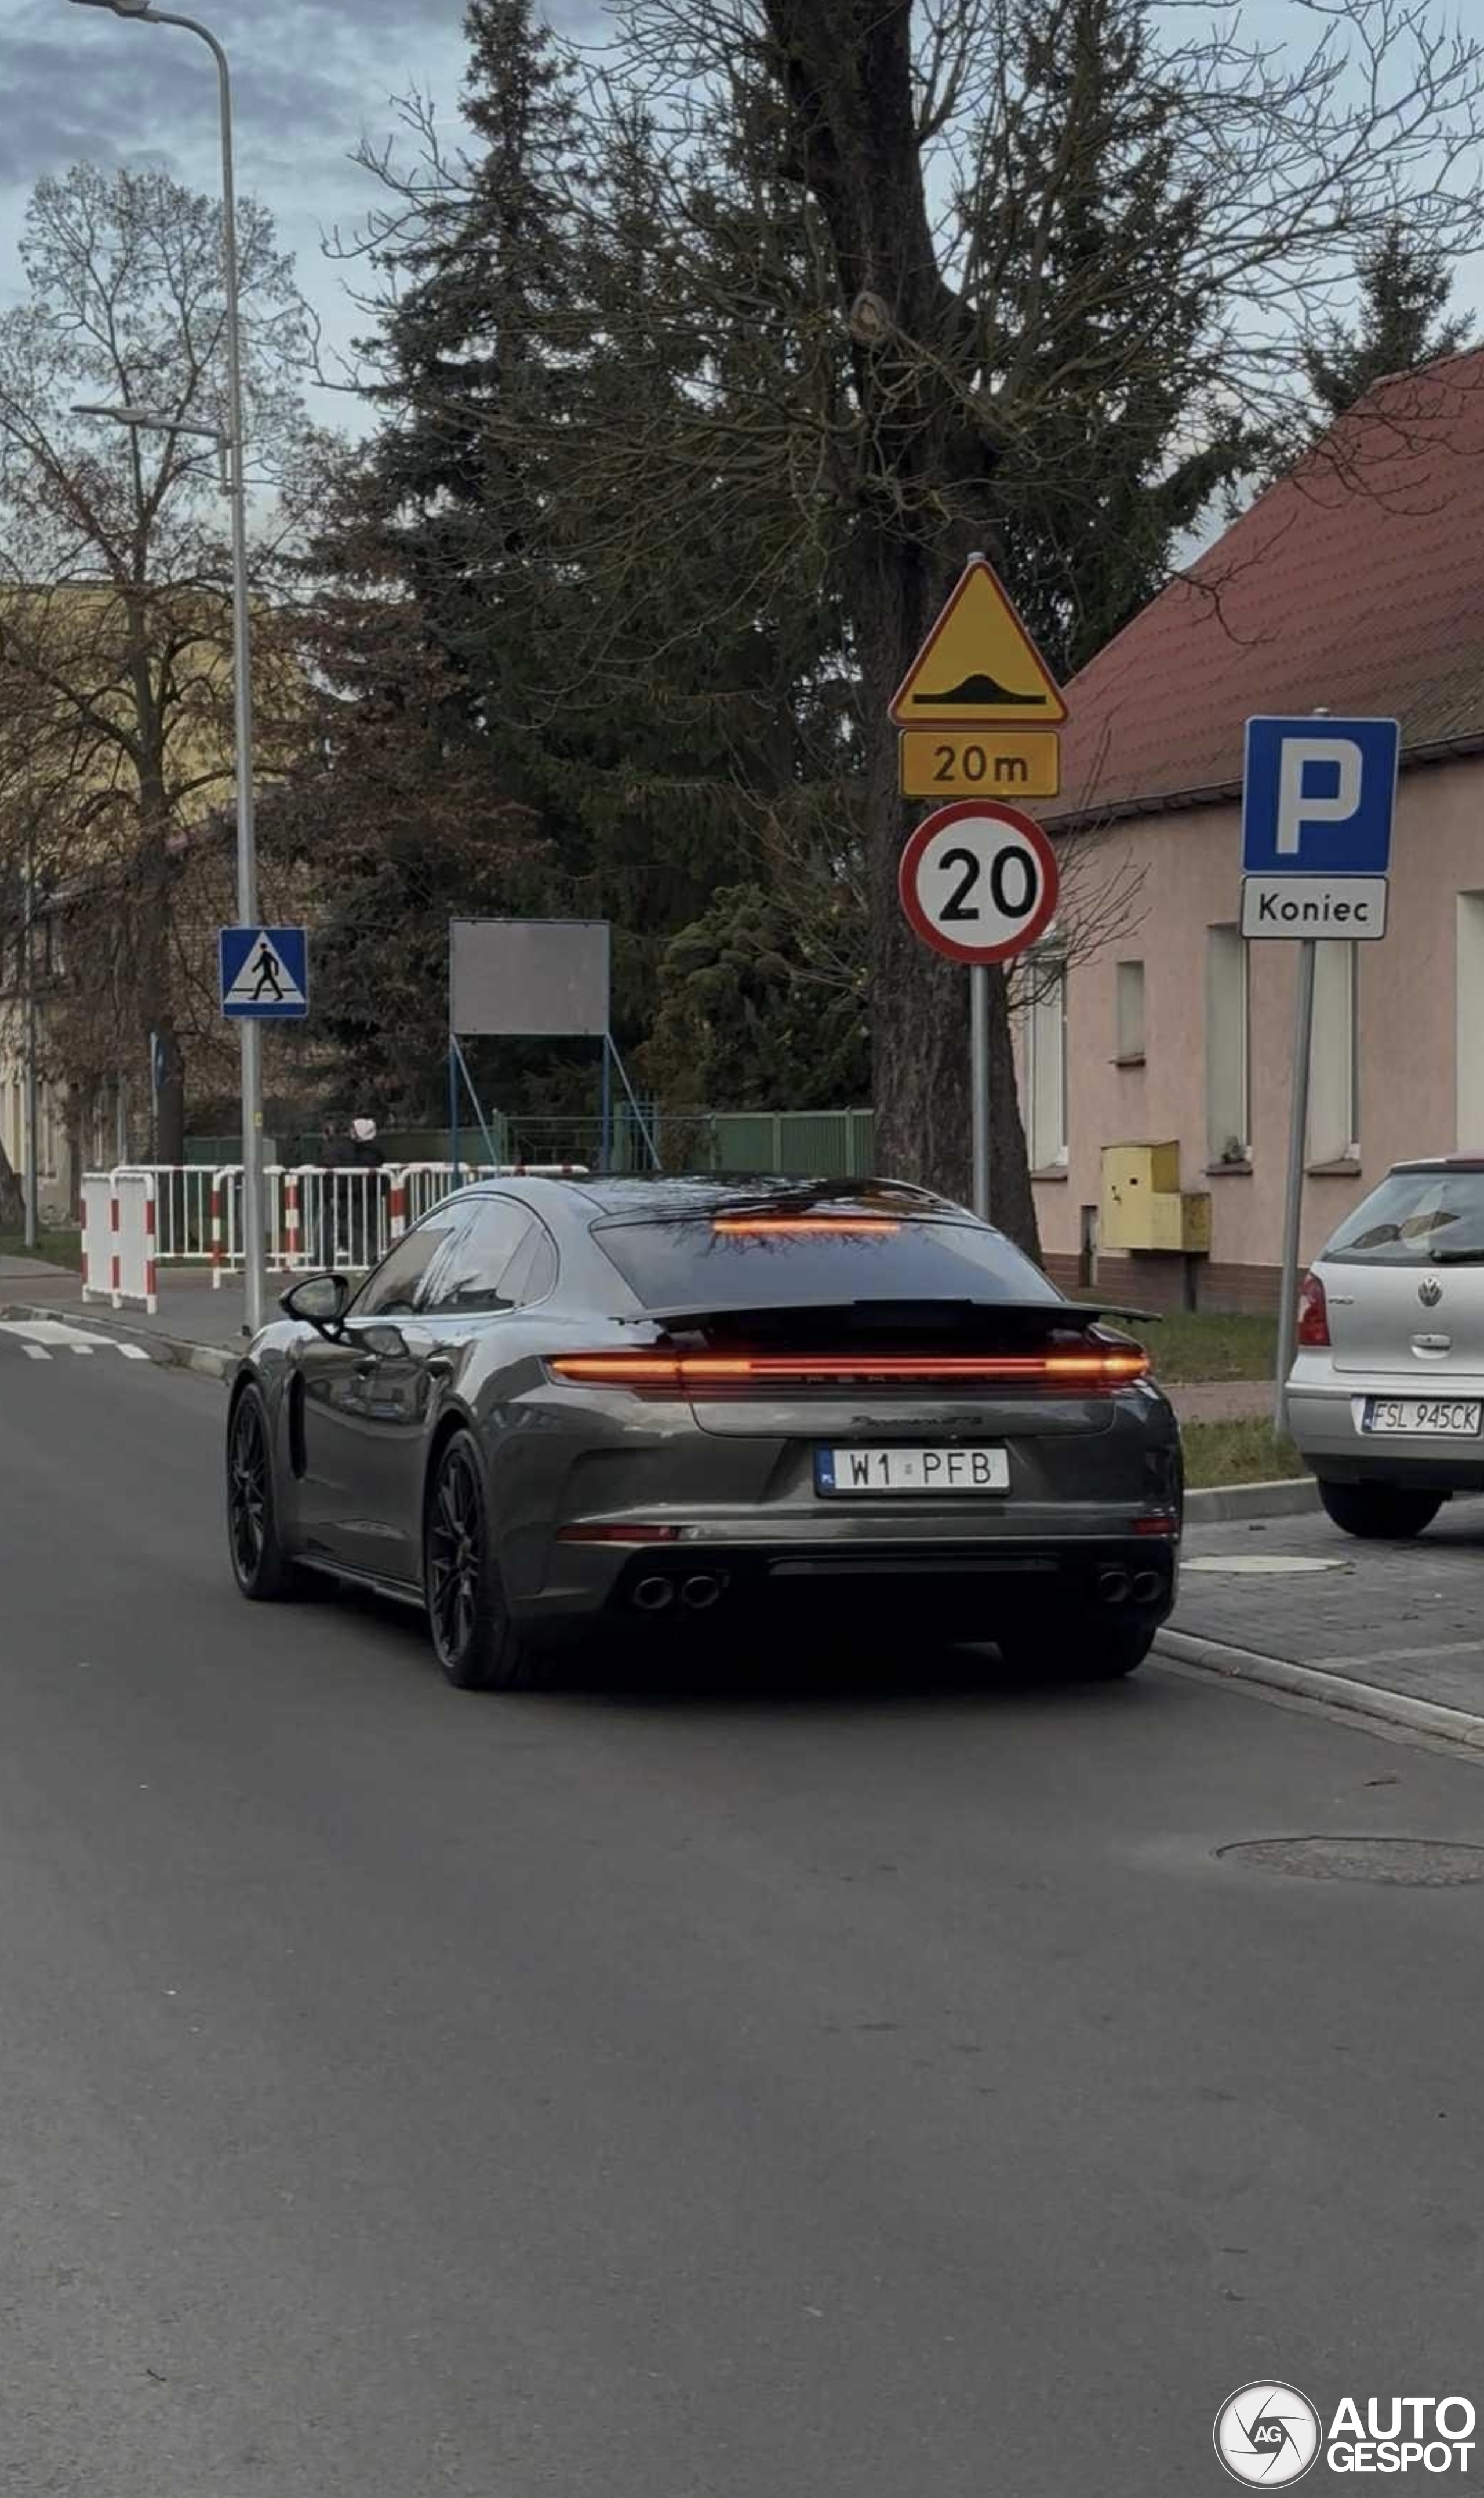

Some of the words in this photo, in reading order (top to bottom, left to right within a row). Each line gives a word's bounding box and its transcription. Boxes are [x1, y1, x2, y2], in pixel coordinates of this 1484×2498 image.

[1276, 738, 1363, 855] P
[939, 846, 1038, 921] 20
[1259, 893, 1369, 921] Koniec
[1375, 1403, 1407, 1428] FSL
[1416, 1404, 1478, 1430] 945CK
[850, 1453, 889, 1485] W1
[923, 1452, 991, 1485] PFB
